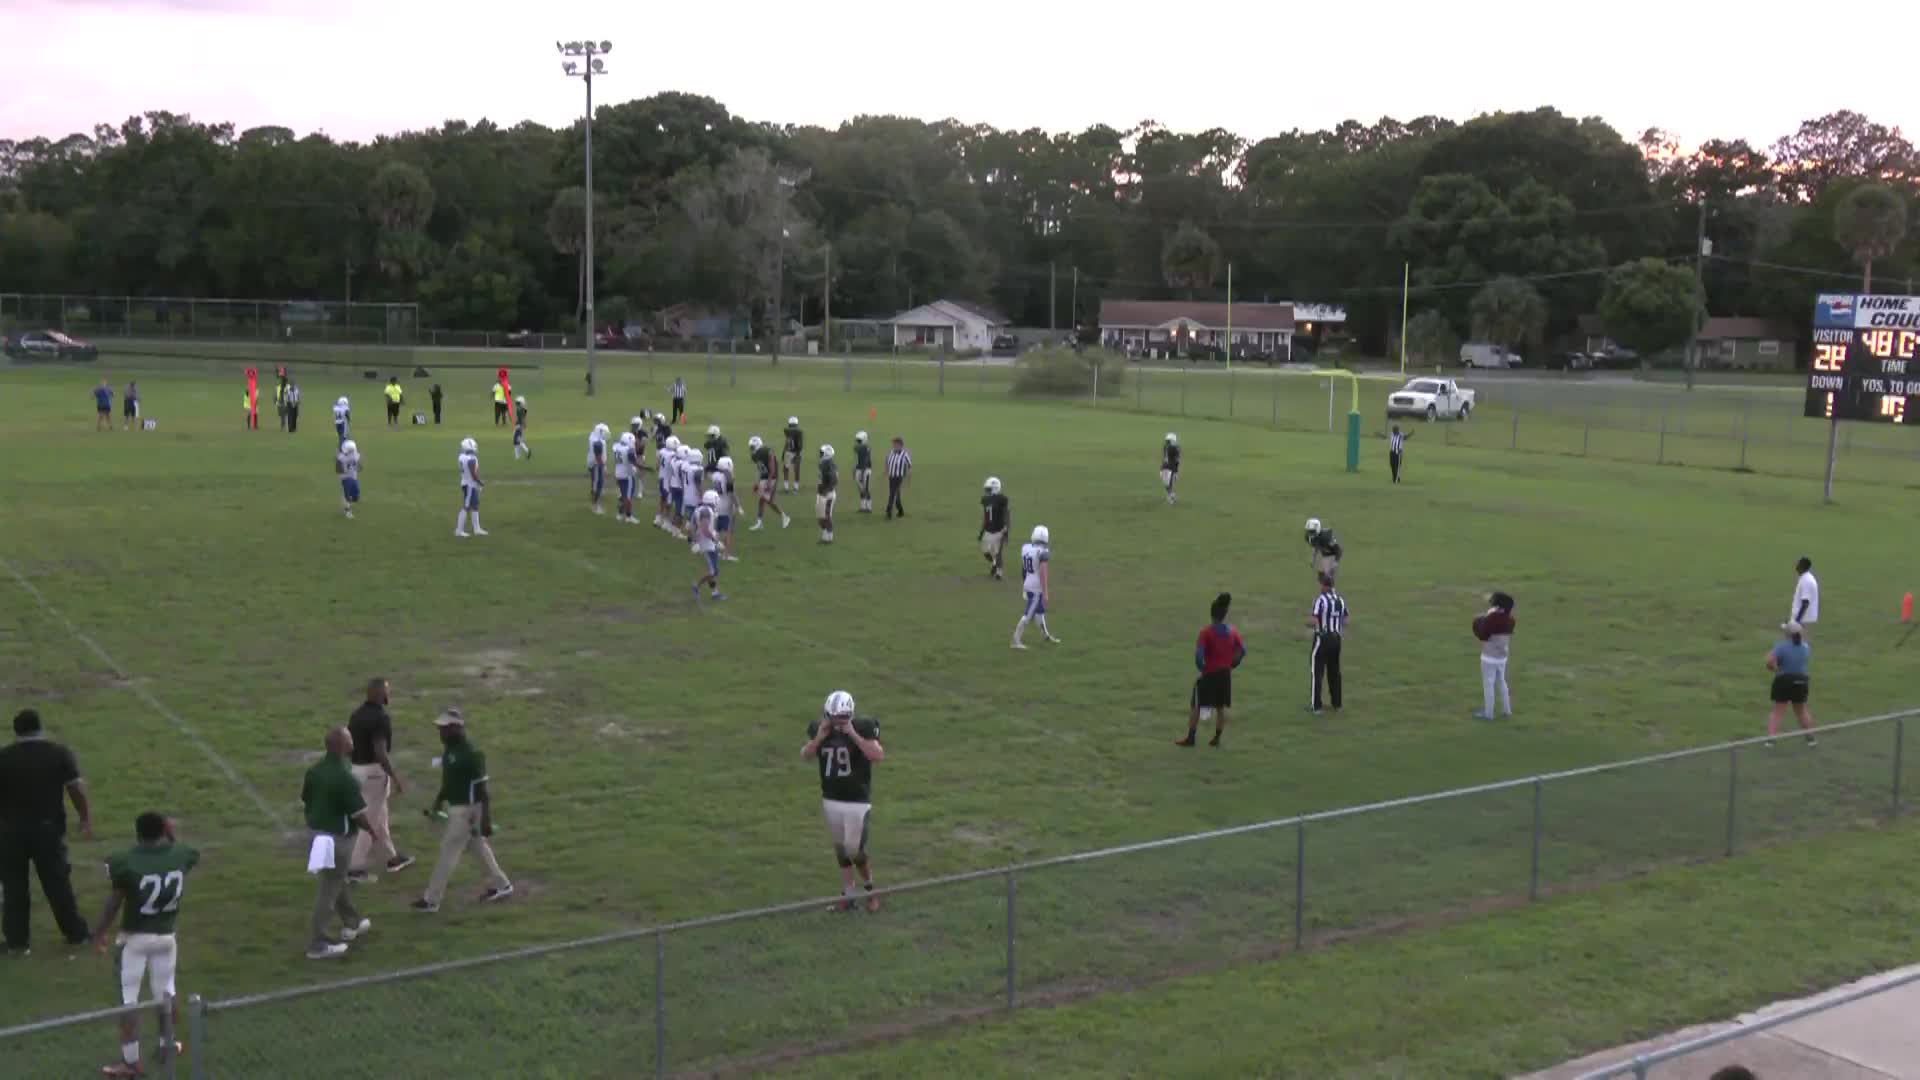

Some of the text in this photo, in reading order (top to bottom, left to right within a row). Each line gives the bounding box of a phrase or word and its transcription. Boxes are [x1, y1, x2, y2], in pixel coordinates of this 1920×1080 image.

[1860, 297, 1911, 310] HOME
[1813, 329, 1854, 343] VISITOR
[1881, 360, 1907, 374] TIME
[1811, 375, 1843, 389] DOWN
[1889, 381, 1904, 393] TO
[821, 746, 852, 777] 79
[139, 871, 183, 914] 22
